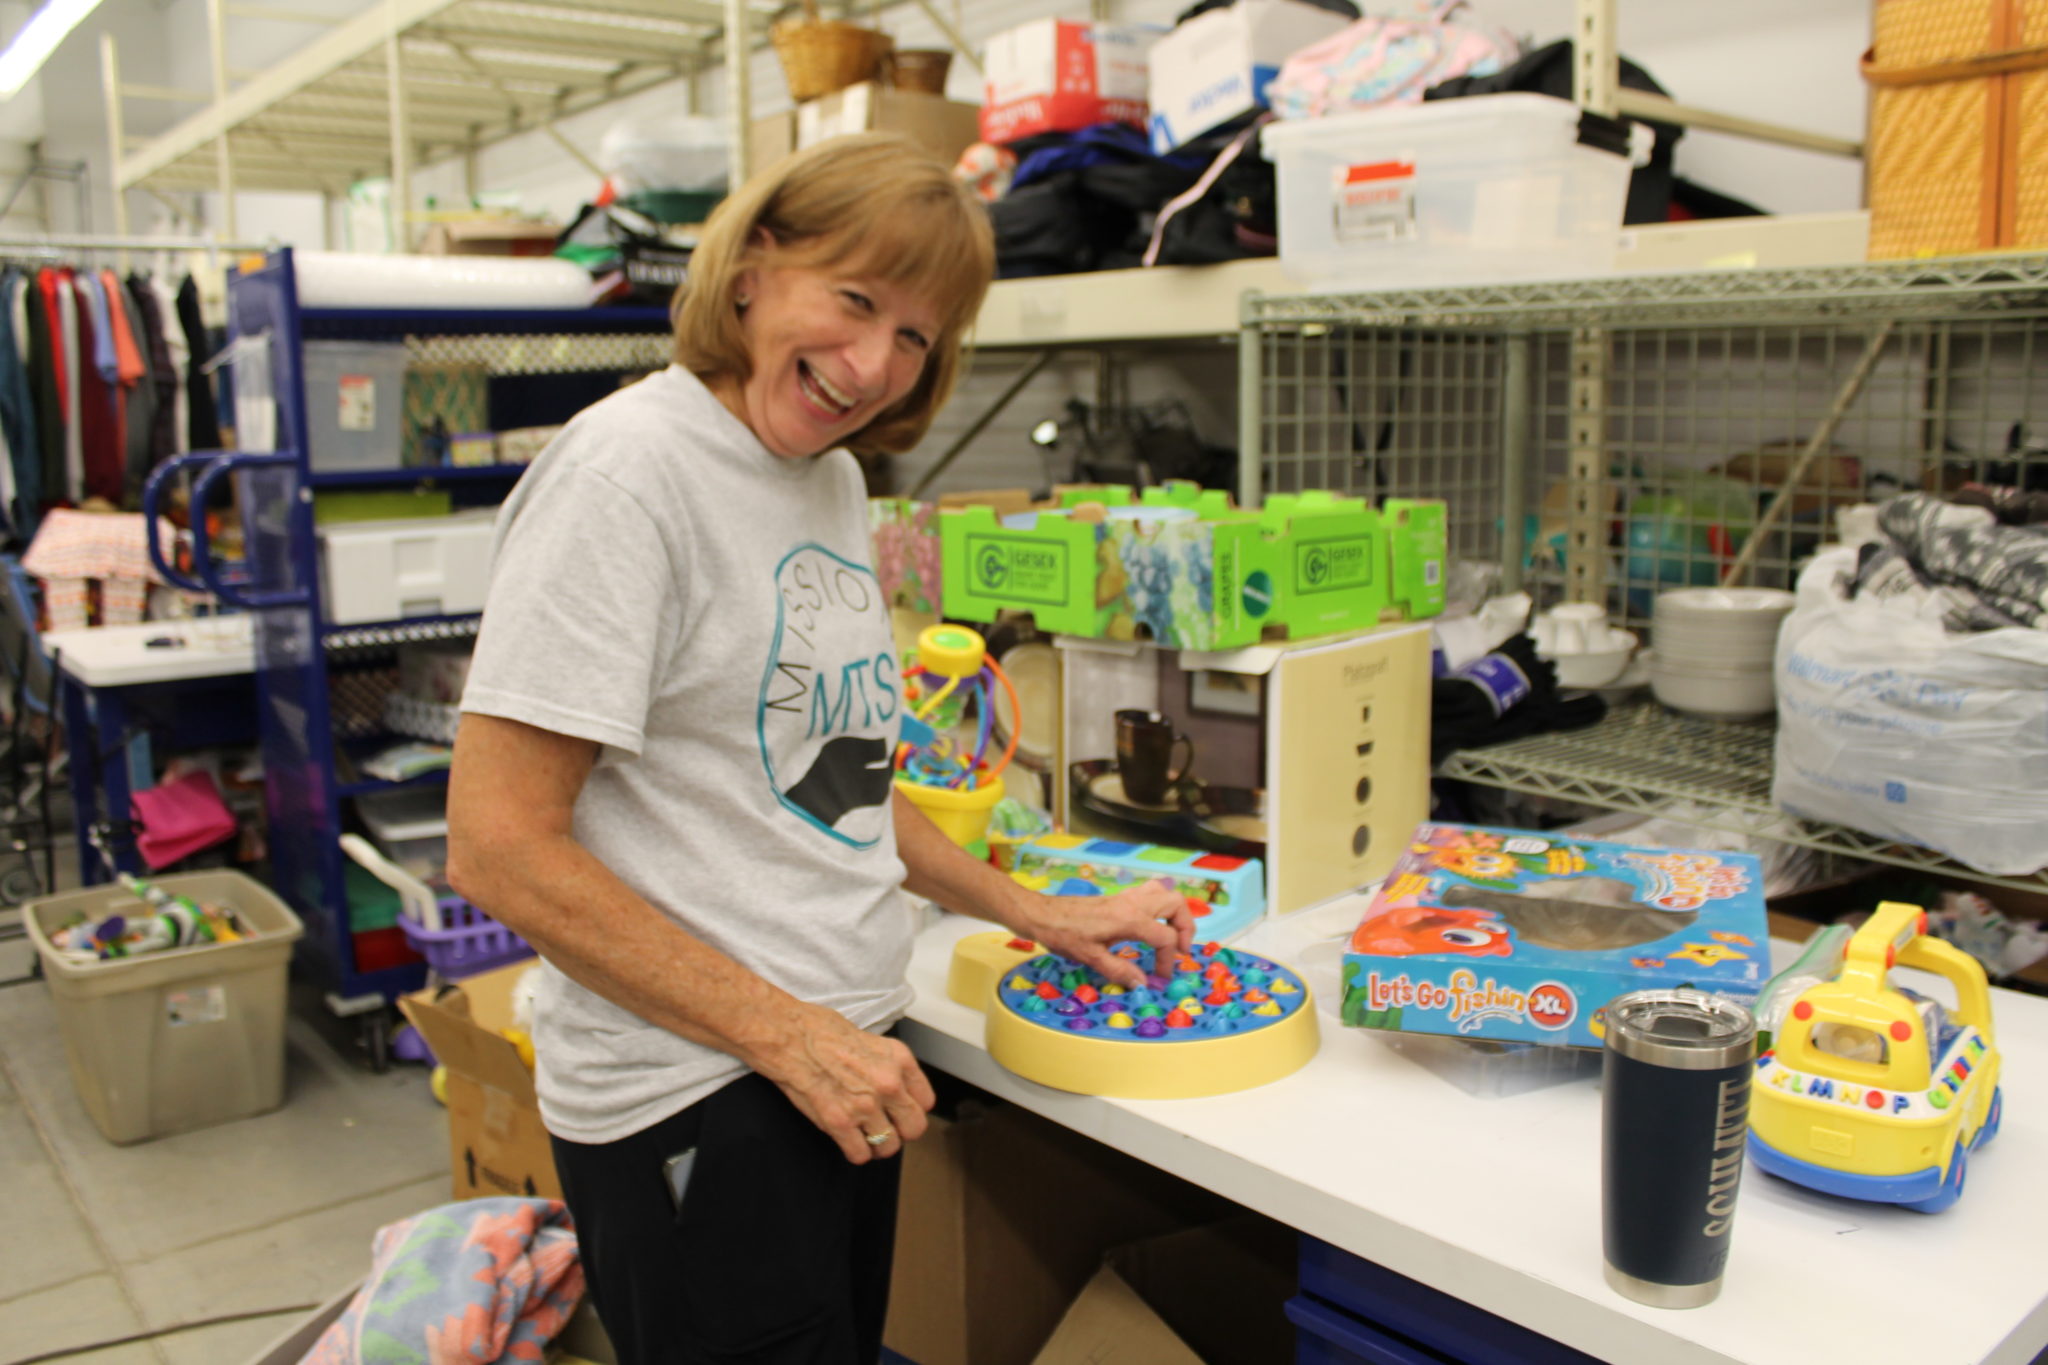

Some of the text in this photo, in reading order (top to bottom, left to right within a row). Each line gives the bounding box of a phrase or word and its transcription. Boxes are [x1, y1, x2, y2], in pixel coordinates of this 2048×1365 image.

[805, 652, 897, 741] MTS
[1369, 973, 1413, 1009] Let's
[1417, 982, 1448, 1008] Go
[1533, 993, 1568, 1017] XL
